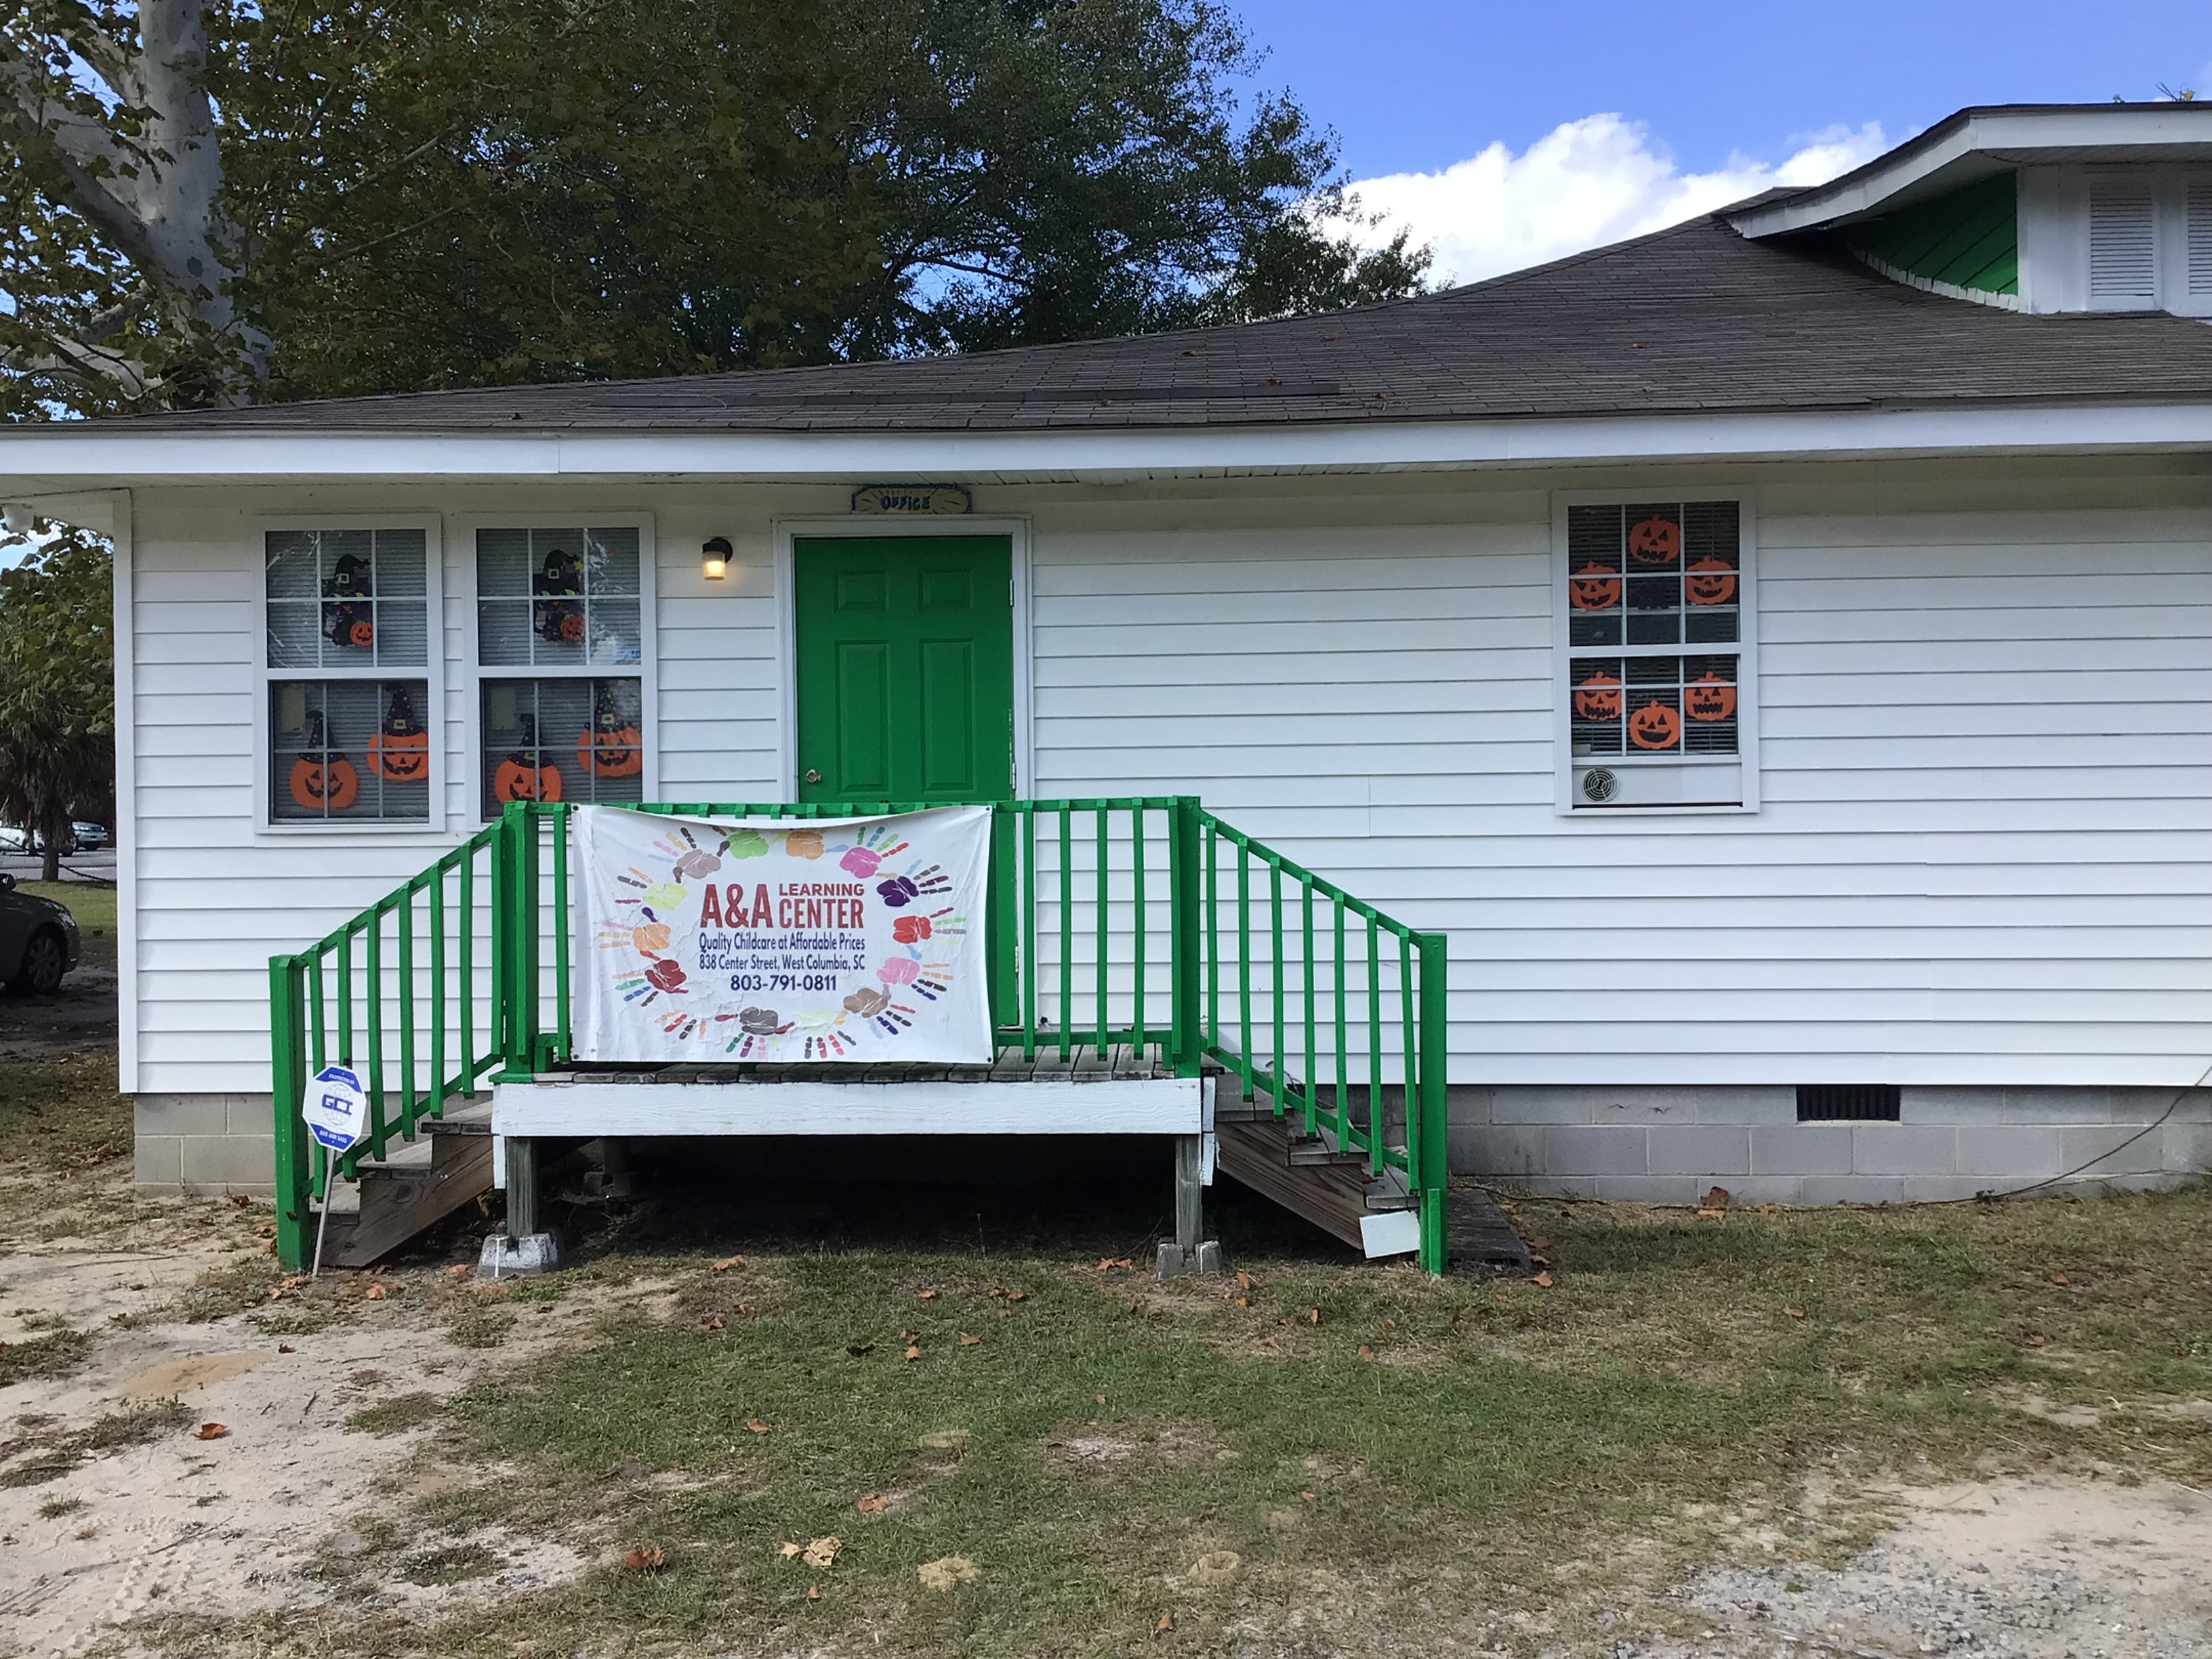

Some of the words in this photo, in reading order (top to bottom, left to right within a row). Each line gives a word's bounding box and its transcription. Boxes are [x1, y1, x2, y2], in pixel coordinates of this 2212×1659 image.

[779, 884, 865, 896] LEARNING
[700, 884, 774, 928] A&A
[779, 899, 864, 928] CENTER
[699, 933, 732, 954] Quality
[734, 932, 776, 950] Childcare
[779, 935, 787, 950] at
[790, 932, 837, 950] Affordable
[839, 933, 865, 950] Prices
[699, 955, 716, 970] 838
[718, 955, 748, 970] Center
[751, 955, 780, 972] Street,
[781, 956, 804, 970] West
[806, 954, 851, 972] Columbia,
[853, 955, 865, 970] SC
[731, 975, 837, 991] 803-791-0811
[322, 1094, 353, 1115] GCI
